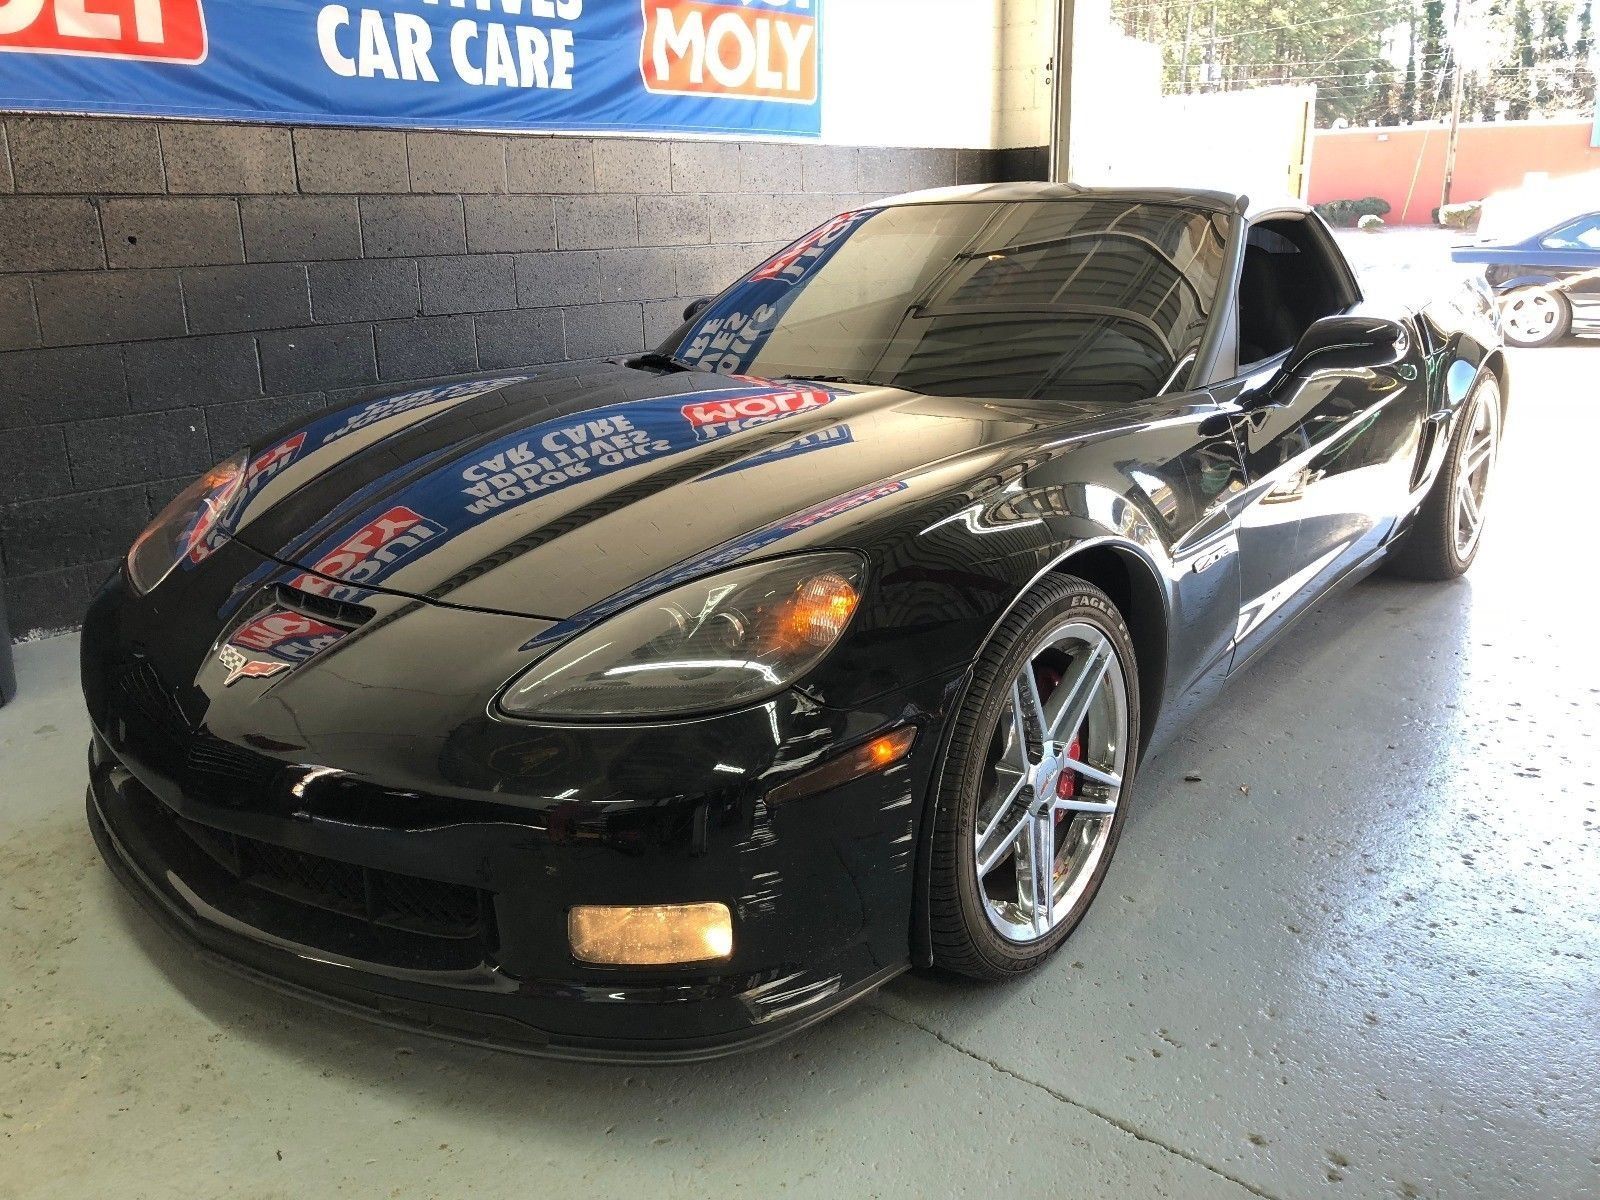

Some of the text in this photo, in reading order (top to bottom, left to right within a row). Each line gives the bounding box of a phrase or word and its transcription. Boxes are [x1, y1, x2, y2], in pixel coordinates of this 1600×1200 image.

[317, 4, 574, 90] CAR CARE
[652, 7, 814, 91] MOLY
[1070, 595, 1116, 617] EAGLE
